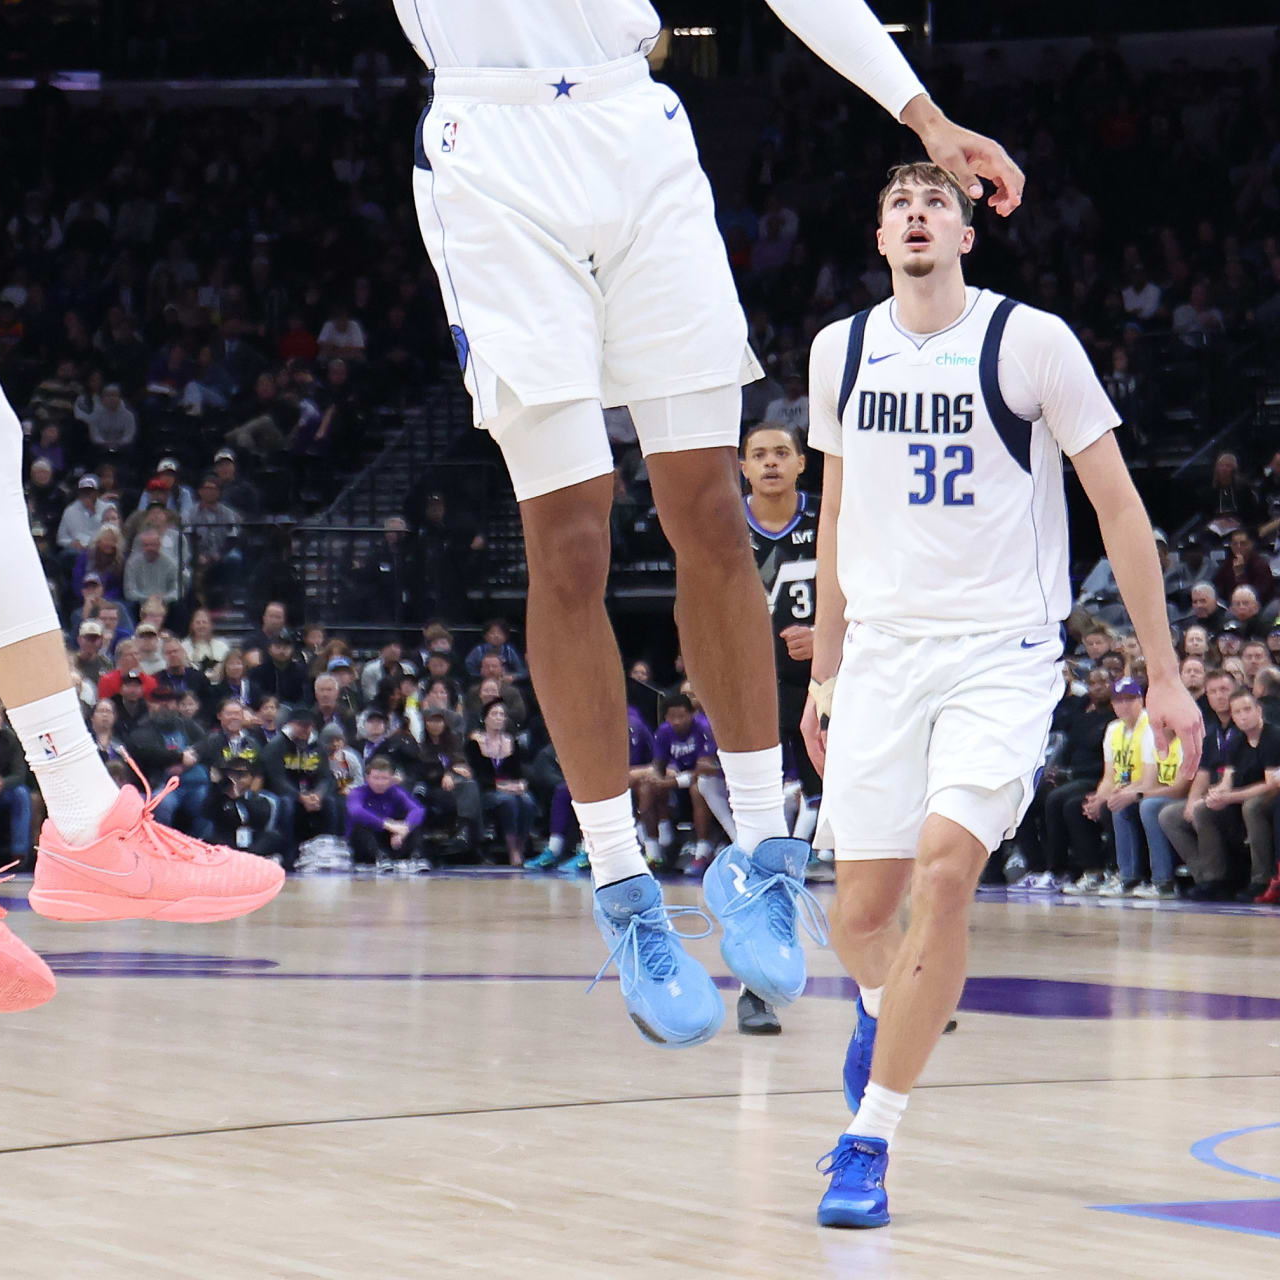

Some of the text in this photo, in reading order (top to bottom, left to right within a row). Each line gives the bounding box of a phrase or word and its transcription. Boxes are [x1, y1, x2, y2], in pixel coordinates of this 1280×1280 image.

[935, 352, 977, 366] chime
[857, 390, 975, 435] DALLAS
[908, 443, 975, 506] 32
[789, 581, 812, 619] 3
